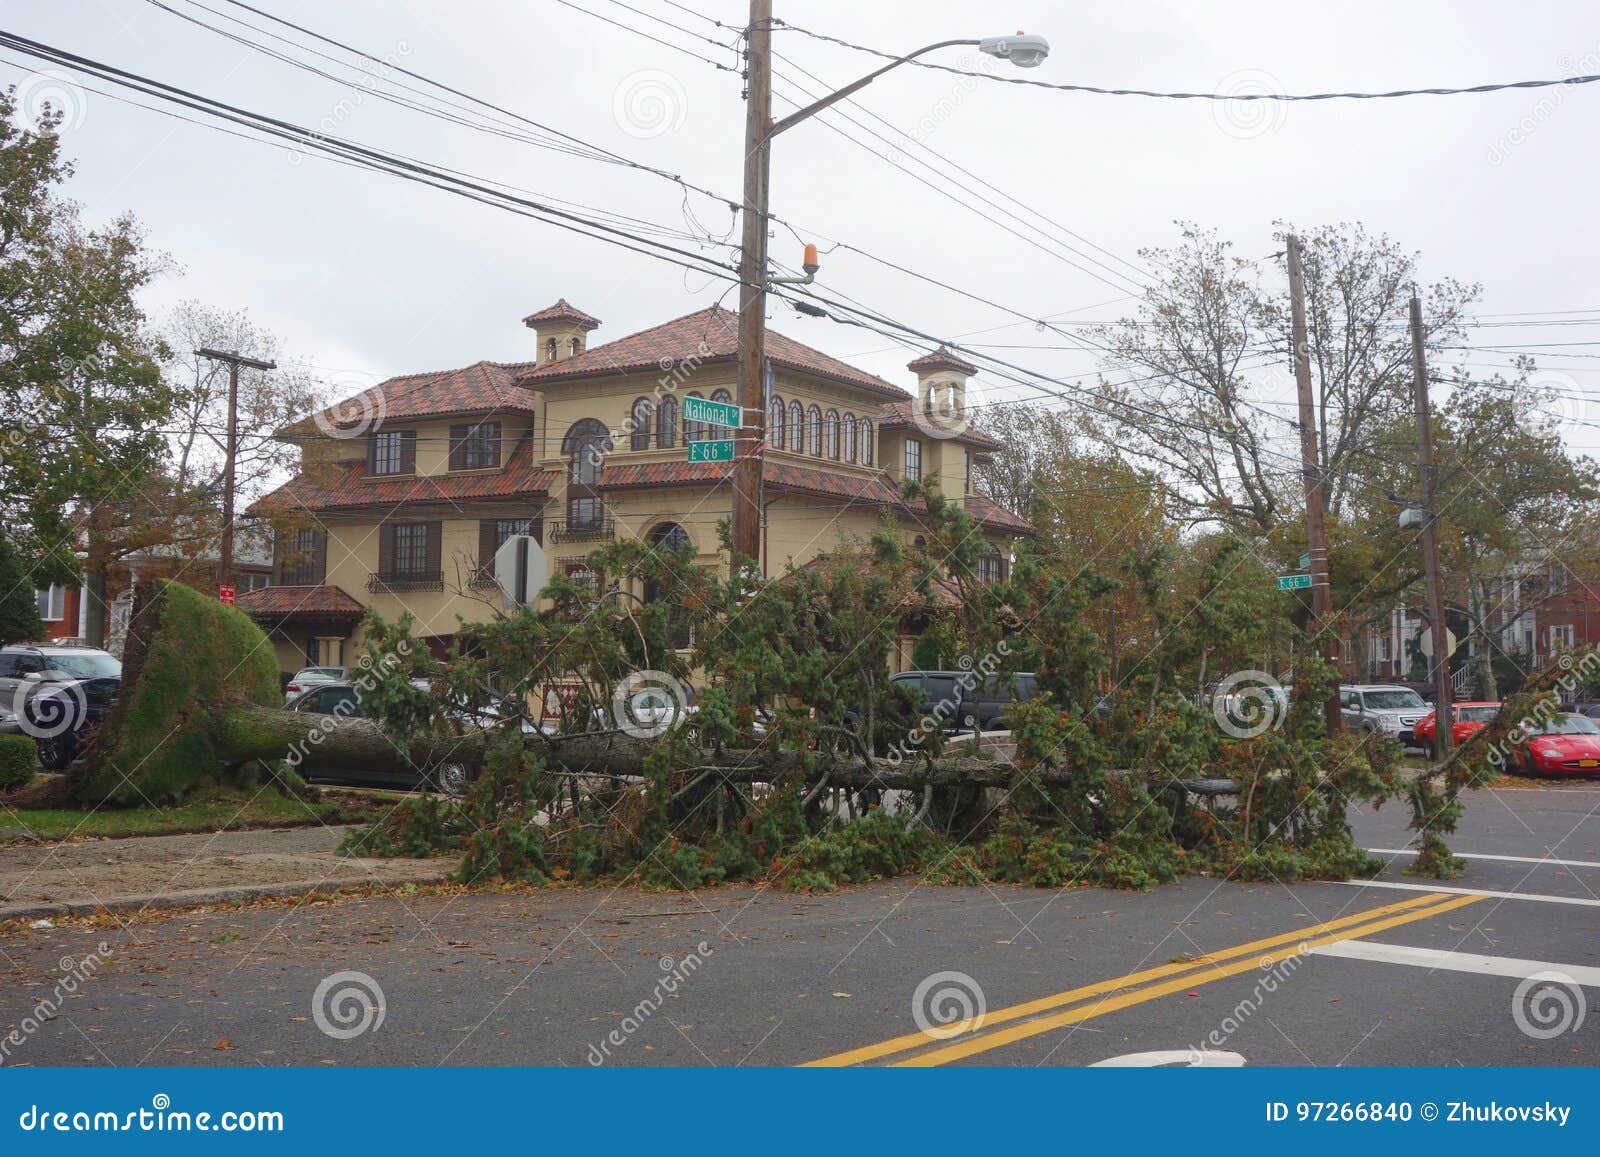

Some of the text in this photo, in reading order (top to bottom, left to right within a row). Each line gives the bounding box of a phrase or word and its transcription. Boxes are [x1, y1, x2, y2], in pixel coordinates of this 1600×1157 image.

[685, 400, 729, 424] National
[691, 442, 732, 460] E 66 St
